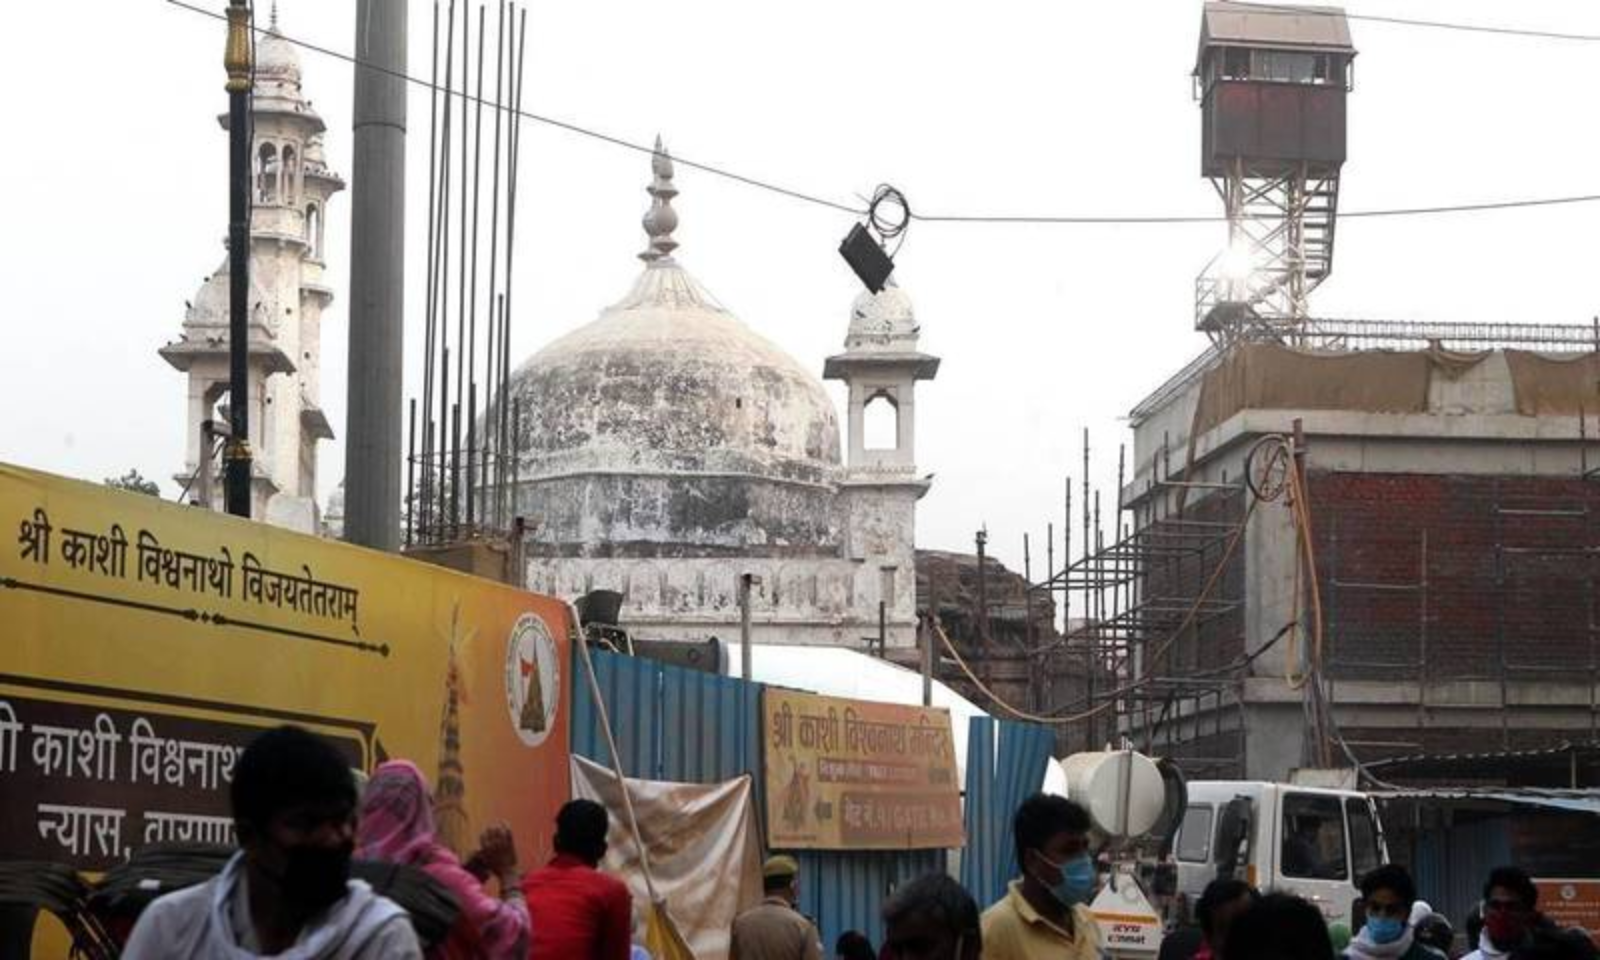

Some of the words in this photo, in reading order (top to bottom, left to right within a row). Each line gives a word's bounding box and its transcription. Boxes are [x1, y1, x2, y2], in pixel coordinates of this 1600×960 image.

[18, 507, 52, 564] श्री
[61, 523, 128, 578] काशी
[136, 529, 234, 598] विश्वनाथो
[242, 551, 360, 636] विजयतेतराम्
[31, 713, 122, 781] काशी
[773, 701, 793, 749] श्री
[800, 706, 839, 754] काशी
[37, 803, 132, 864] न्यास,
